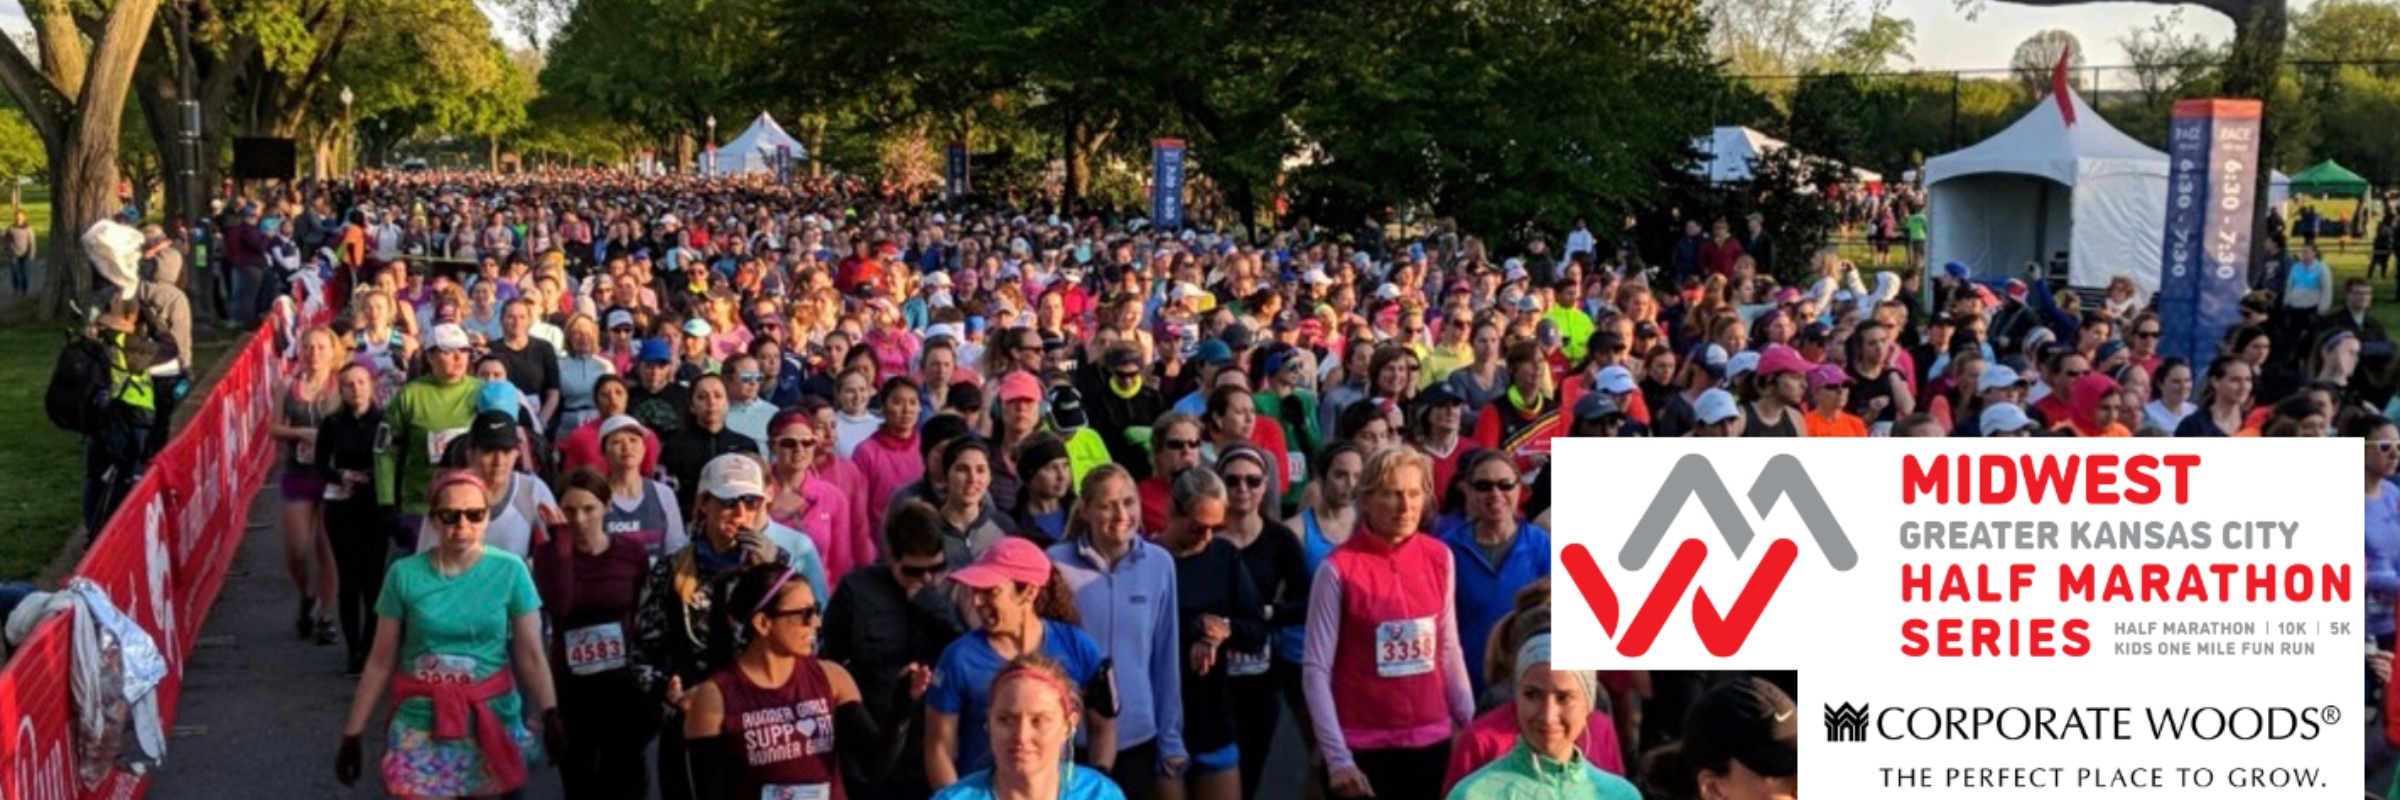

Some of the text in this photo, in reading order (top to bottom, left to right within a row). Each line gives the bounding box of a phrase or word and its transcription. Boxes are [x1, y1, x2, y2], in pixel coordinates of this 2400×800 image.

[2220, 127, 2252, 141] PACE
[2177, 158, 2195, 209] 6:30
[2221, 159, 2243, 211] 6:30
[2171, 228, 2189, 278] 7:30
[2215, 229, 2237, 280] 7:30
[570, 640, 621, 663] 4583
[1383, 637, 1432, 662] 3358
